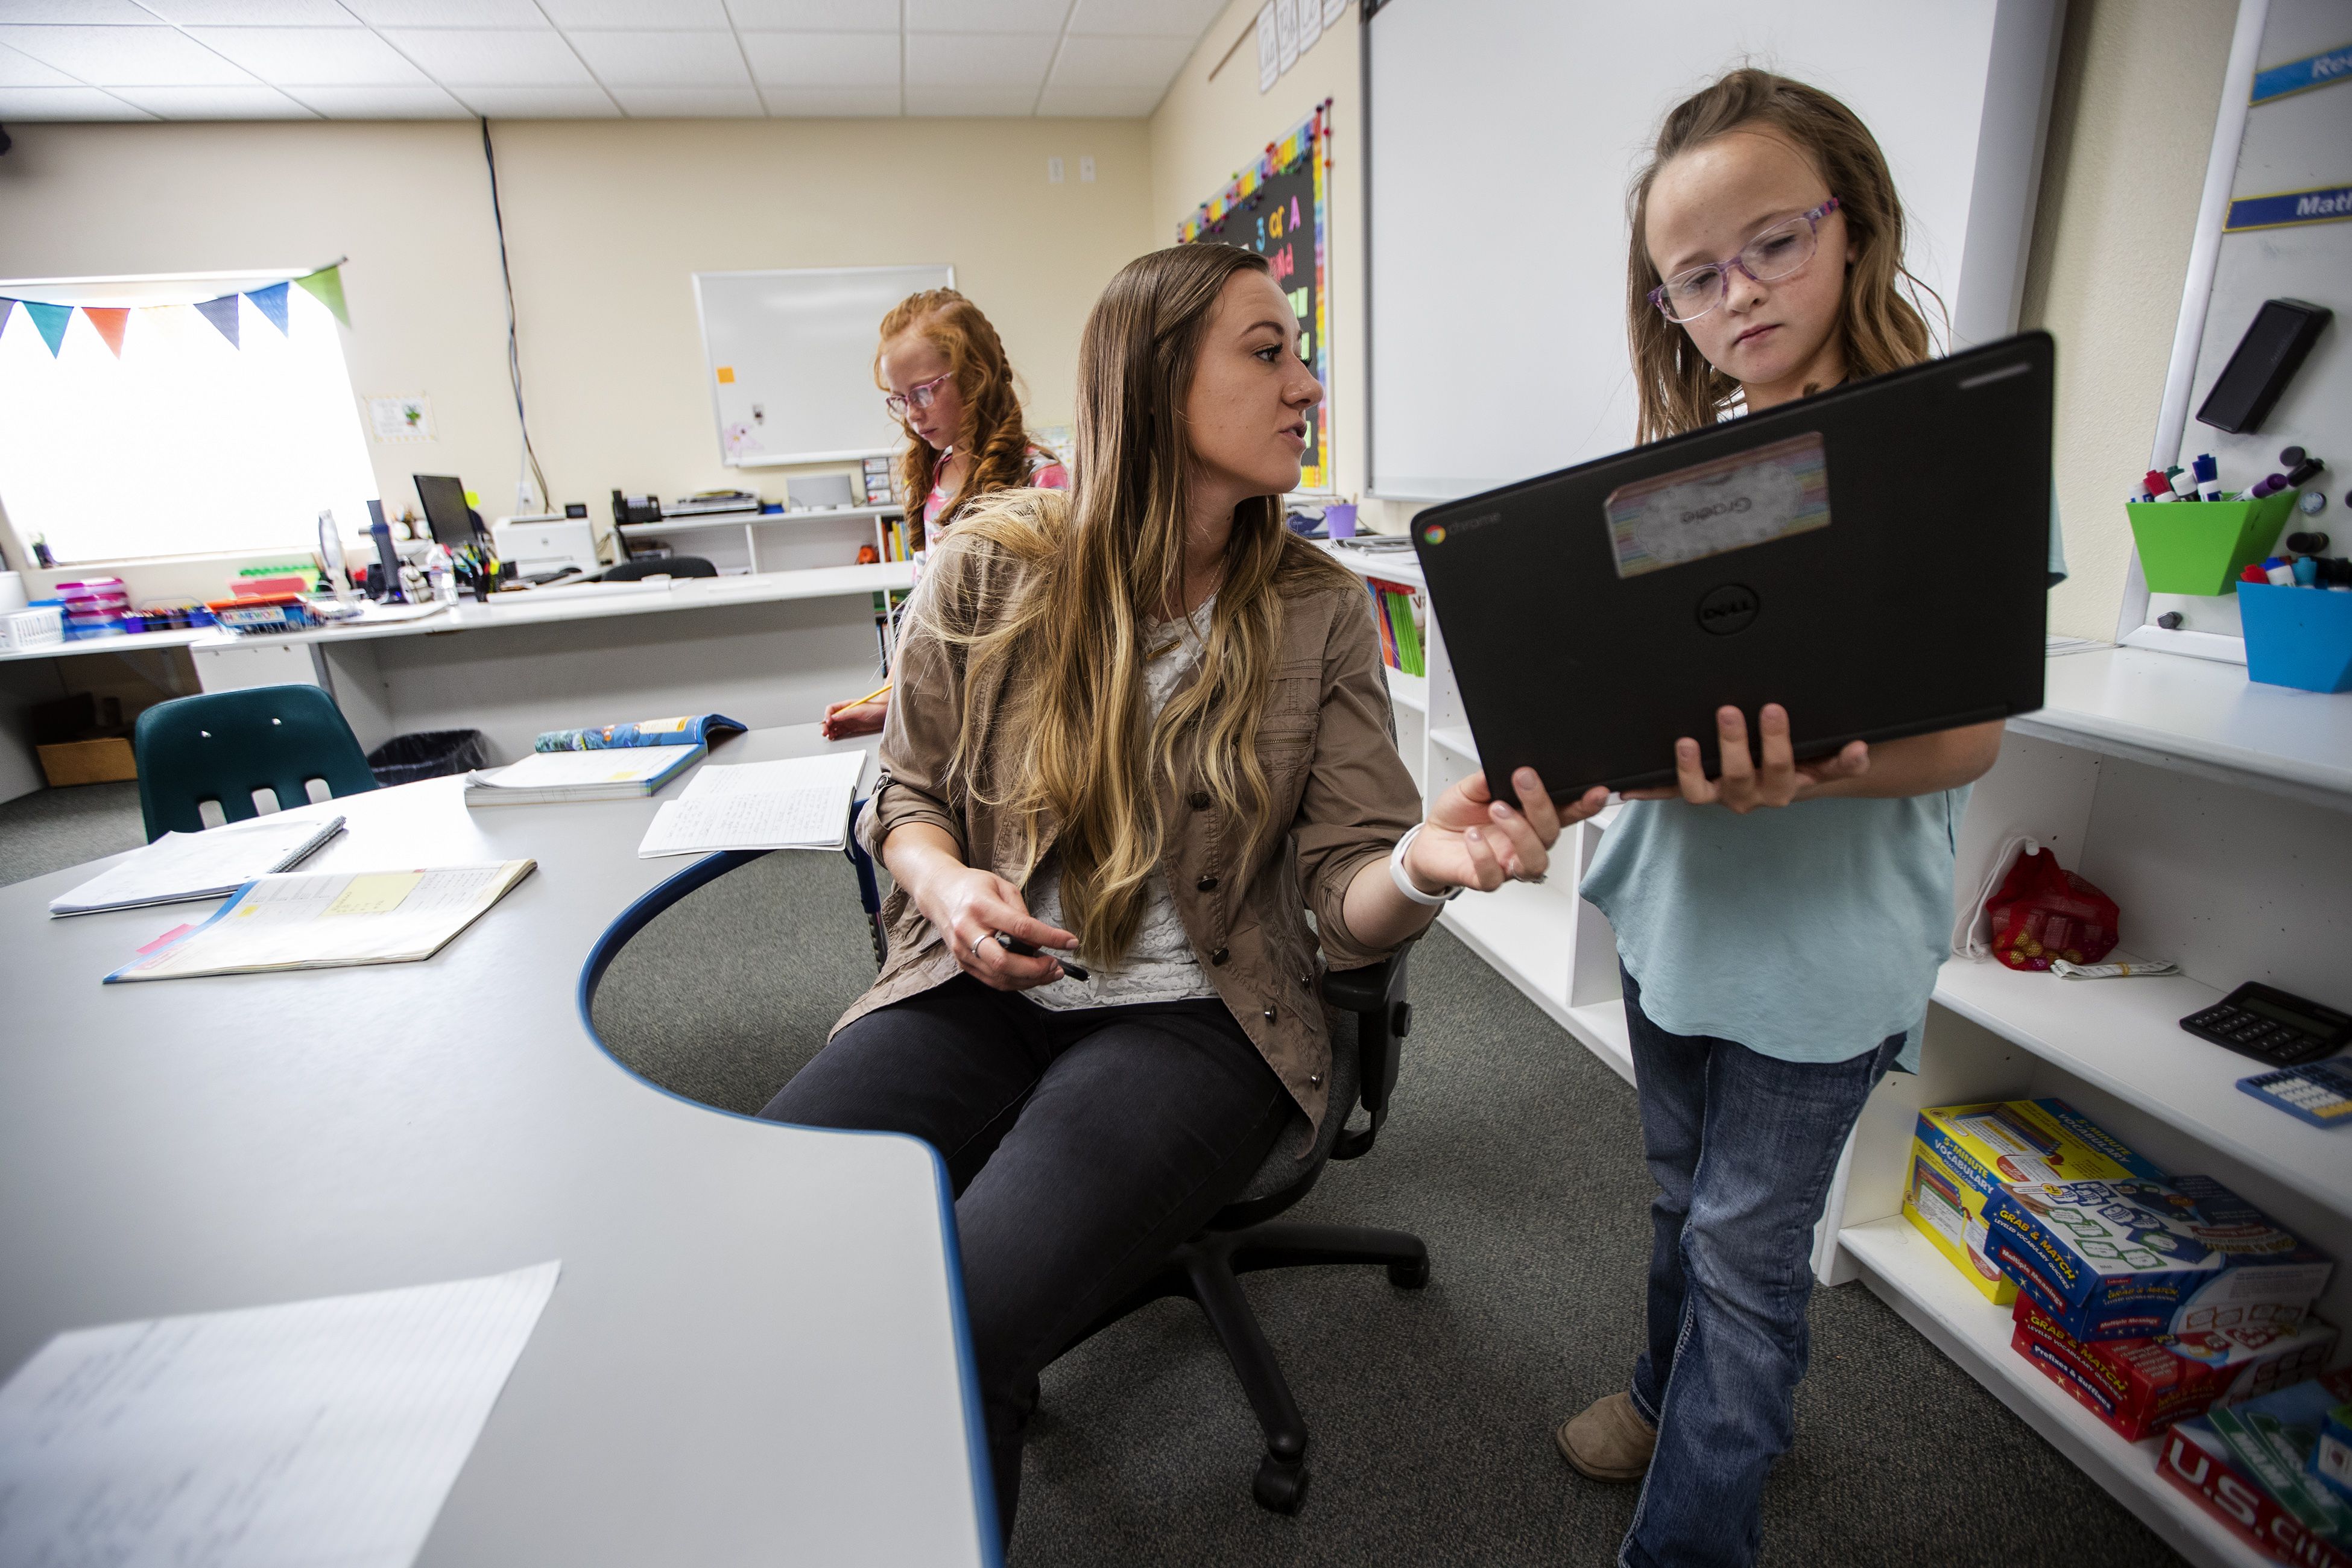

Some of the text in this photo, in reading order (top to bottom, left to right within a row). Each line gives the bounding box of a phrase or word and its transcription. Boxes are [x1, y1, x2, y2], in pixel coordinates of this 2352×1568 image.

[1703, 599, 1751, 620] DELL
[1934, 1139, 1994, 1194] VOCABULARY
[1943, 1137, 1988, 1179] 5-MINUTE
[1994, 1218, 2070, 1290] LEVELED VOCABULARY QUICKIES
[1999, 1210, 2076, 1280] GRAB & MATCH
[2002, 1248, 2031, 1274] Multiple
[2031, 1269, 2064, 1307] Meanings
[2031, 1315, 2066, 1340] GRAB
[2067, 1338, 2078, 1350] &
[2080, 1348, 2126, 1391] MATCH
[2100, 1317, 2158, 1329] Multiple Meanings
[2028, 1324, 2052, 1341] LEVELED
[2053, 1339, 2094, 1372] VOCABULARY
[2094, 1371, 2123, 1402] QUICKIES
[2034, 1344, 2112, 1410] Prefixes & Suffixes
